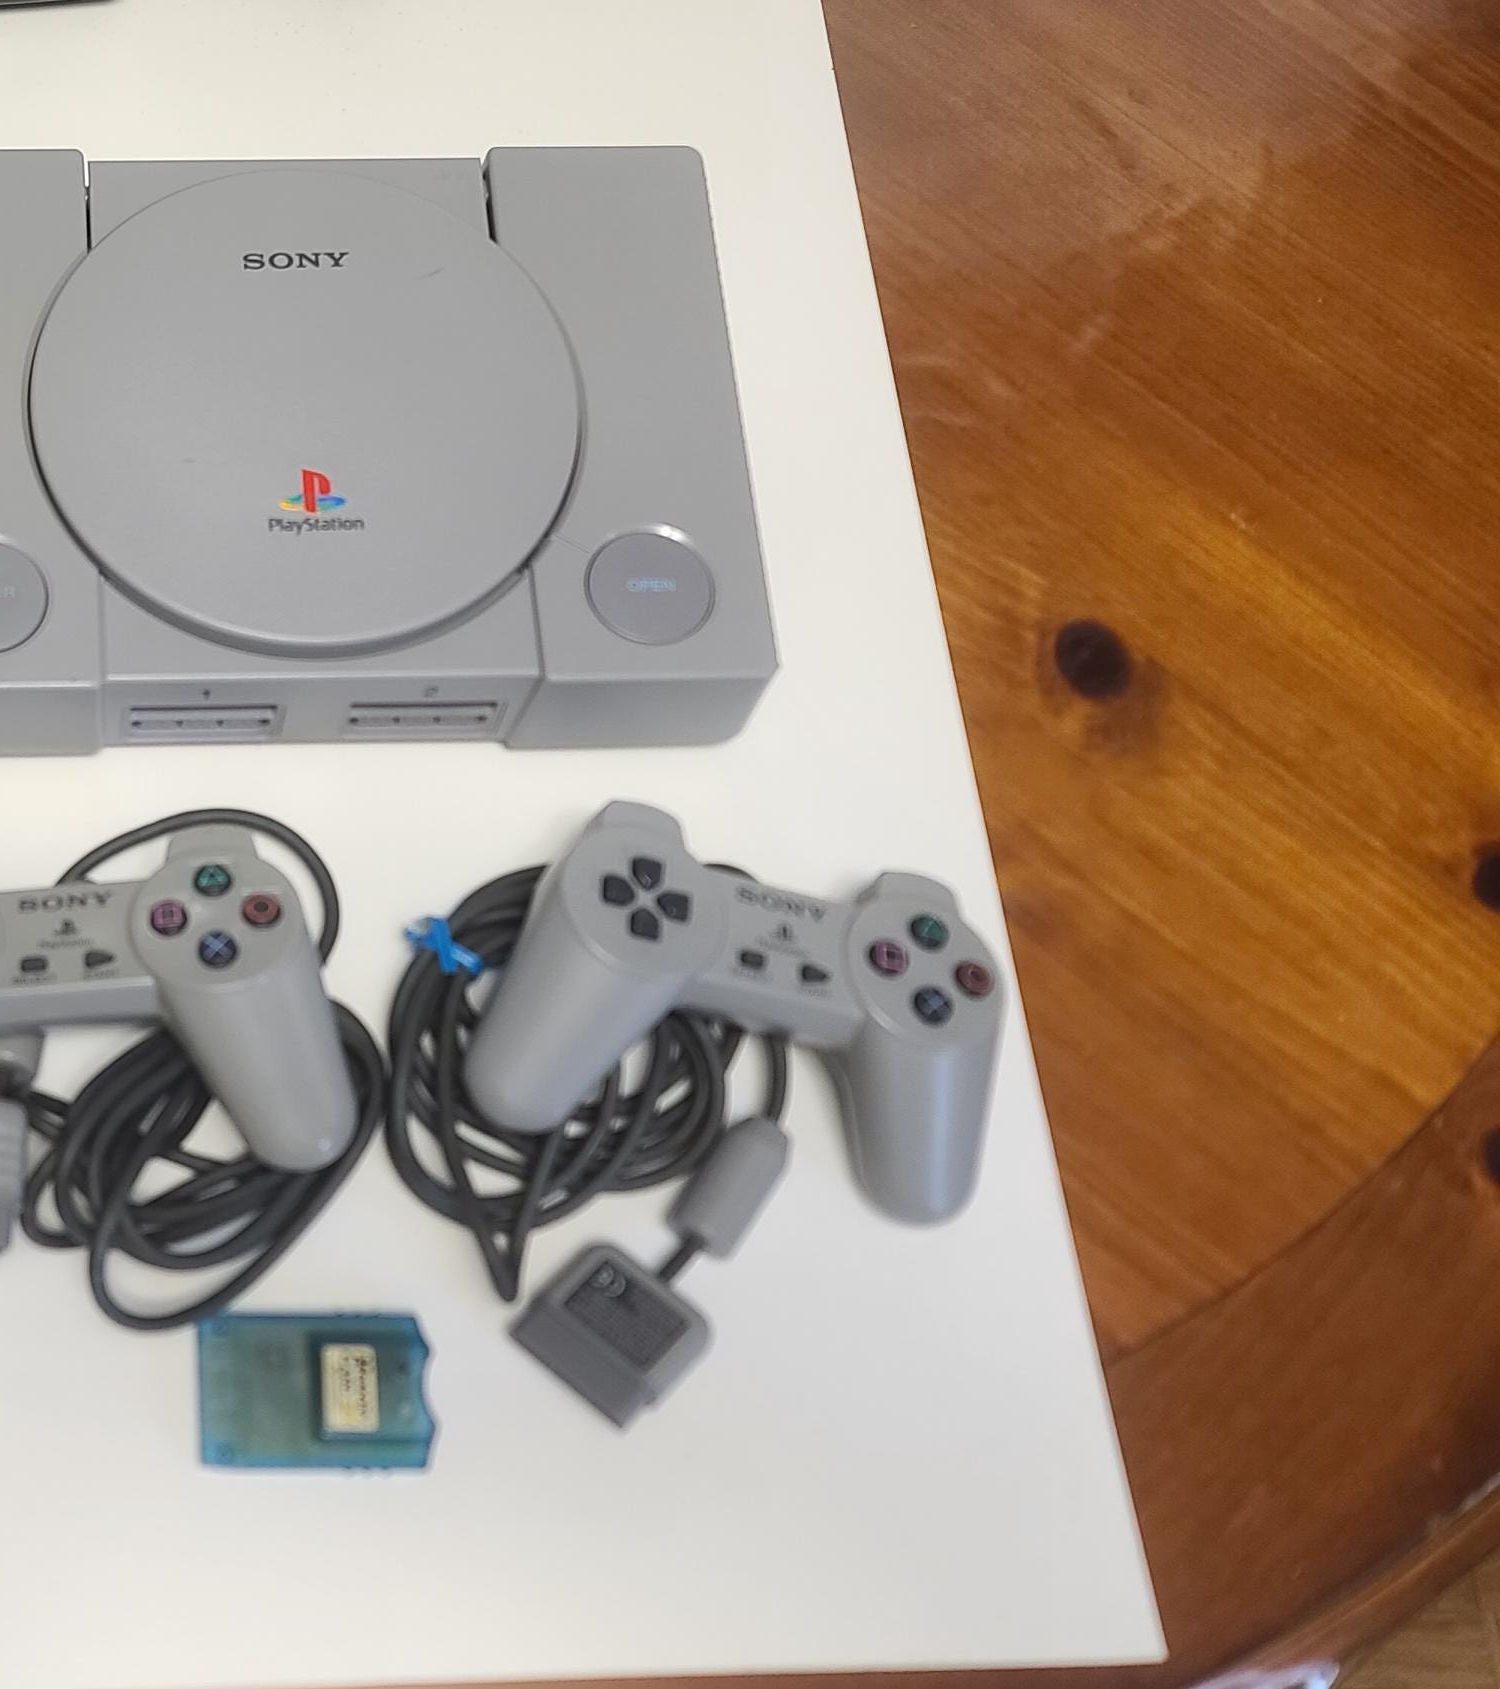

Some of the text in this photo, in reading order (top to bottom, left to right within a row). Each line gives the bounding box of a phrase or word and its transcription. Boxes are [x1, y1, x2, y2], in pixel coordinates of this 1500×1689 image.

[242, 252, 349, 270] SONY
[268, 518, 365, 536] PlayStation
[626, 577, 677, 592] OPEN
[17, 891, 112, 914] SONY
